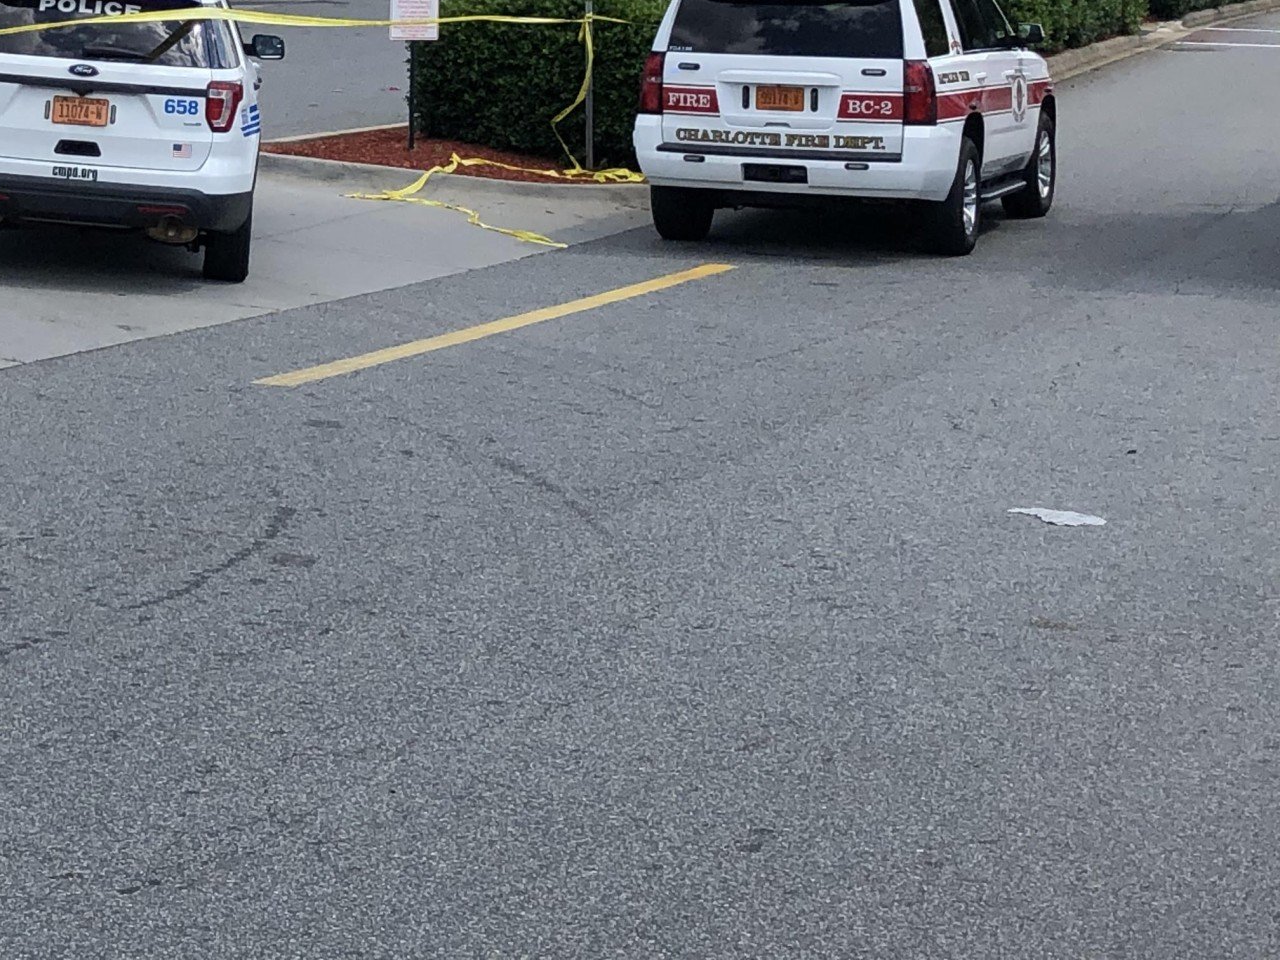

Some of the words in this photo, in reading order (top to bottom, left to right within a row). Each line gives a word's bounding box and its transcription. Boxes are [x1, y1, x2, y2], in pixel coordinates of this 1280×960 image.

[72, 64, 94, 76] Ford
[164, 99, 198, 115] 658
[668, 92, 711, 107] FIRE
[847, 100, 893, 115] BC-2
[675, 127, 781, 147] CHARLOTTE
[785, 134, 830, 148] FIRE
[833, 135, 886, 150] DEPT.
[52, 166, 98, 181] cmpd.org
